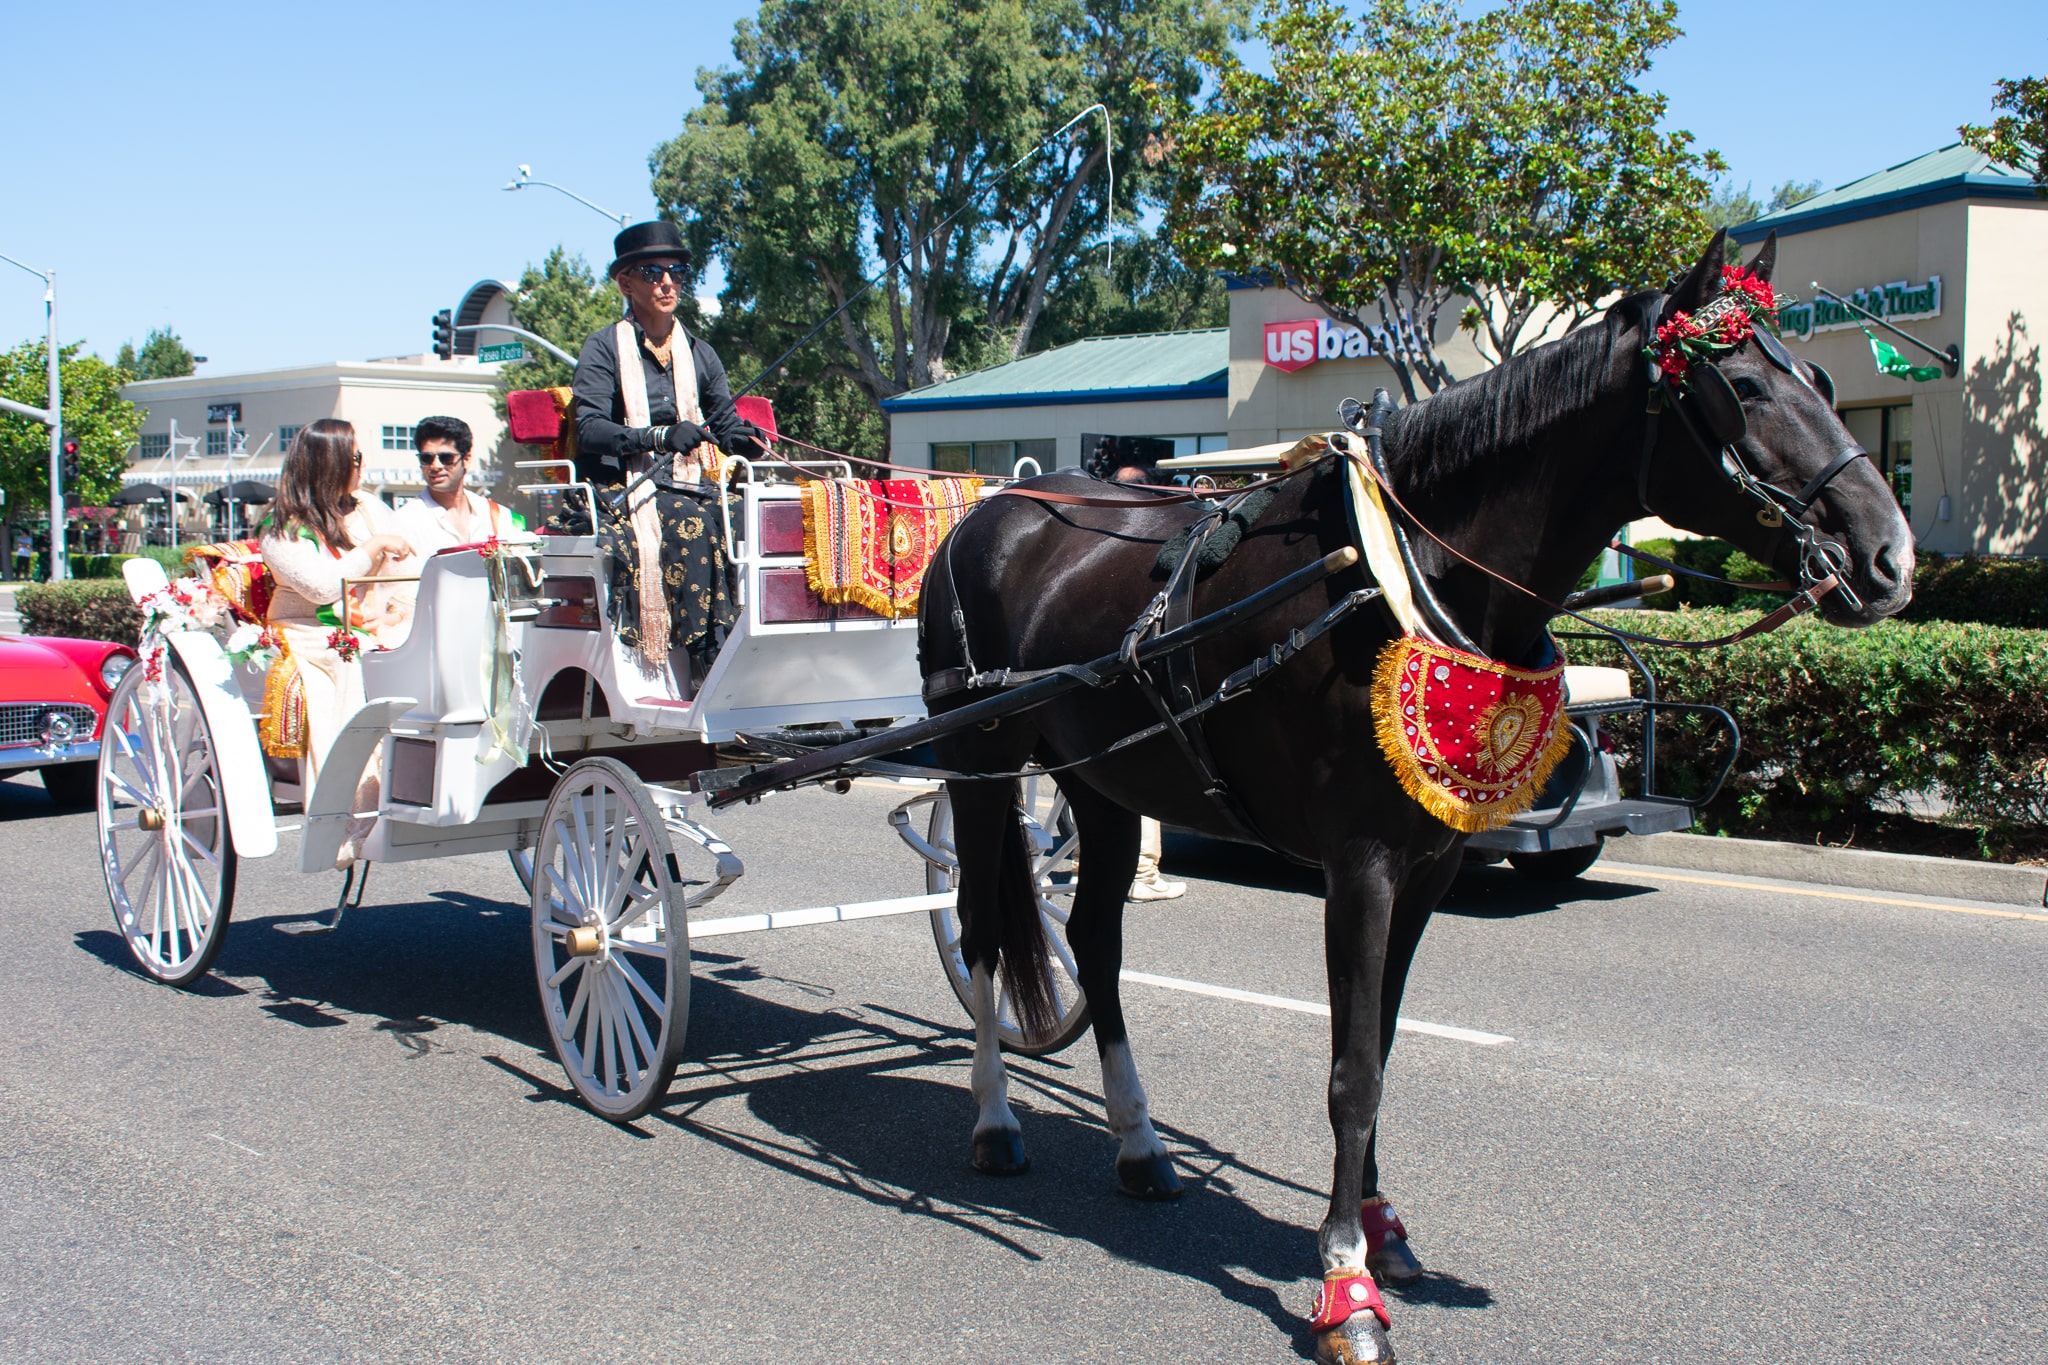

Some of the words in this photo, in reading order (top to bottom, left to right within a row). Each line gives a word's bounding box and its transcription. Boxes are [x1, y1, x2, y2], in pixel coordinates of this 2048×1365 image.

[1884, 278, 1938, 318] Trust
[479, 348, 500, 362] Paseo
[501, 345, 521, 360] Padre
